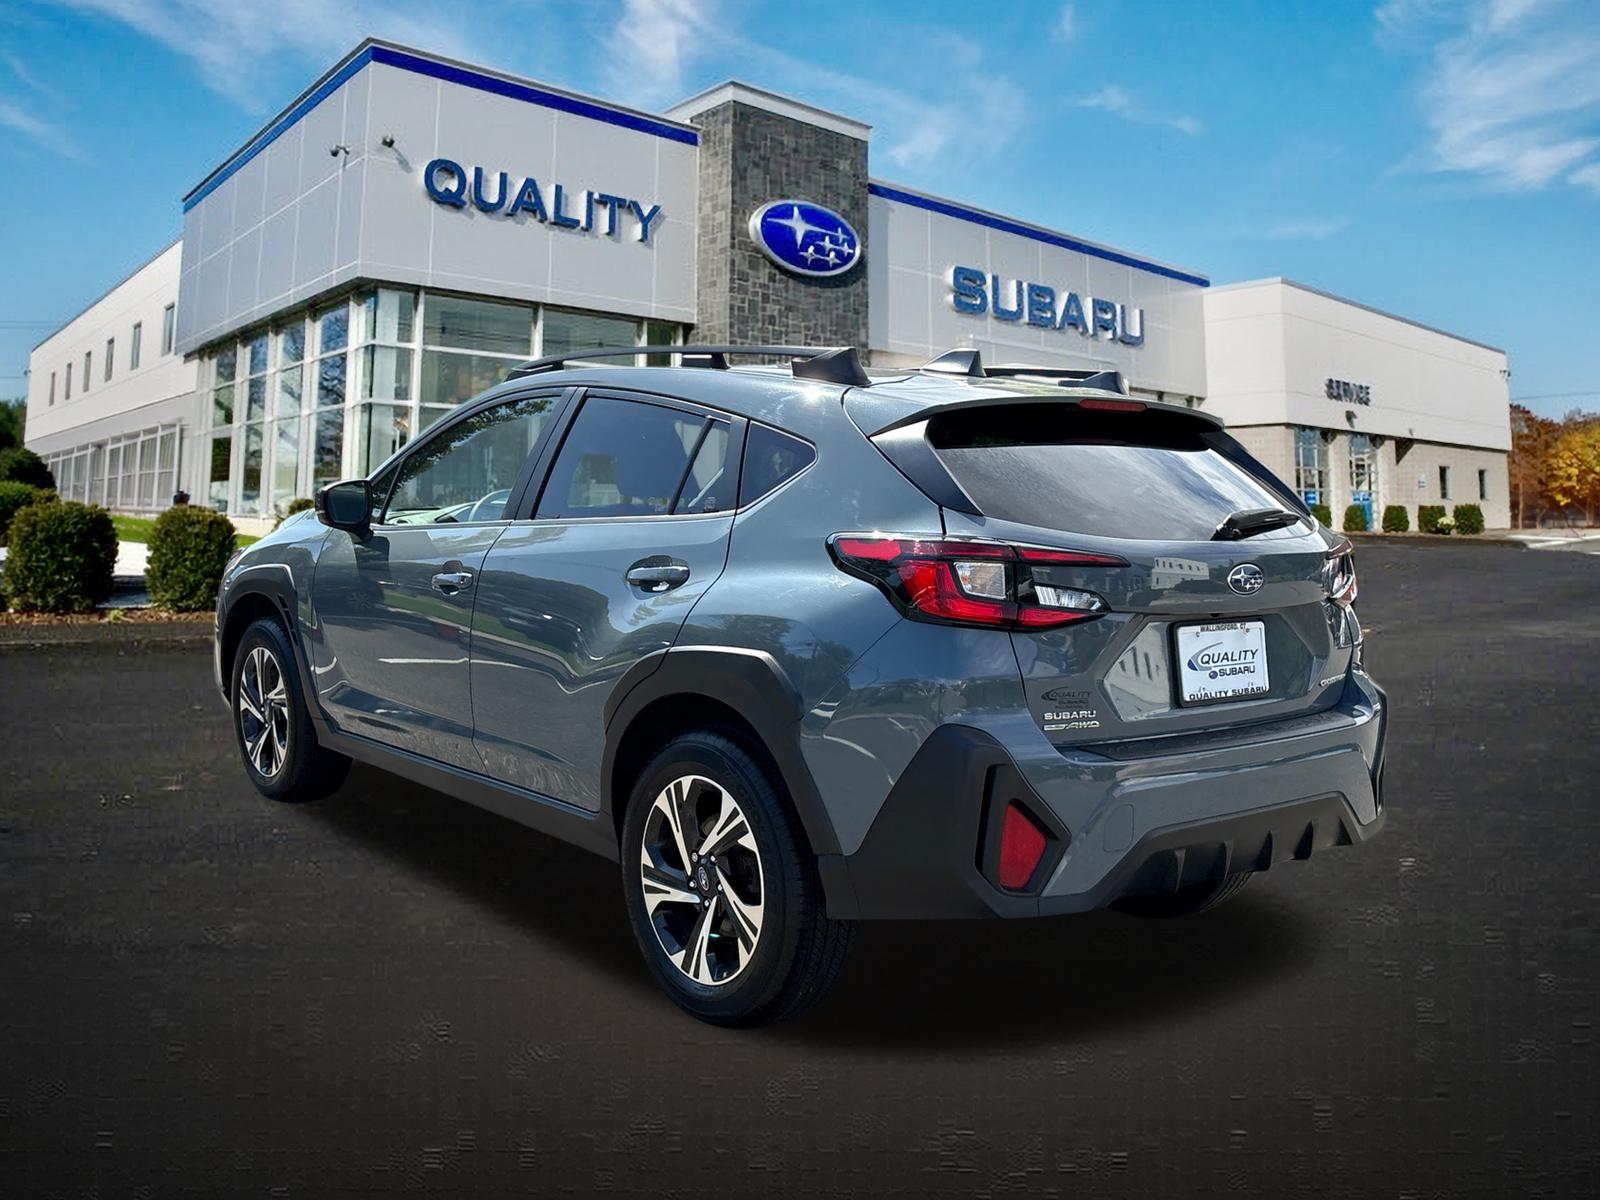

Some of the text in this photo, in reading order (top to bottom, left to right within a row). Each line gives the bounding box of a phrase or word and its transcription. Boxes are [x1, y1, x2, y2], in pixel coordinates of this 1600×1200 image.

[424, 158, 661, 243] QUALITY
[949, 265, 1145, 347] SUBARU
[1325, 378, 1370, 407] SERVICE
[1200, 649, 1258, 665] QUALITY
[1218, 665, 1256, 677] SUBARU
[1188, 690, 1229, 700] QUALITY
[1231, 685, 1267, 696] SUBARU
[1043, 710, 1097, 720] SUBARU
[1065, 720, 1101, 730] AWD
